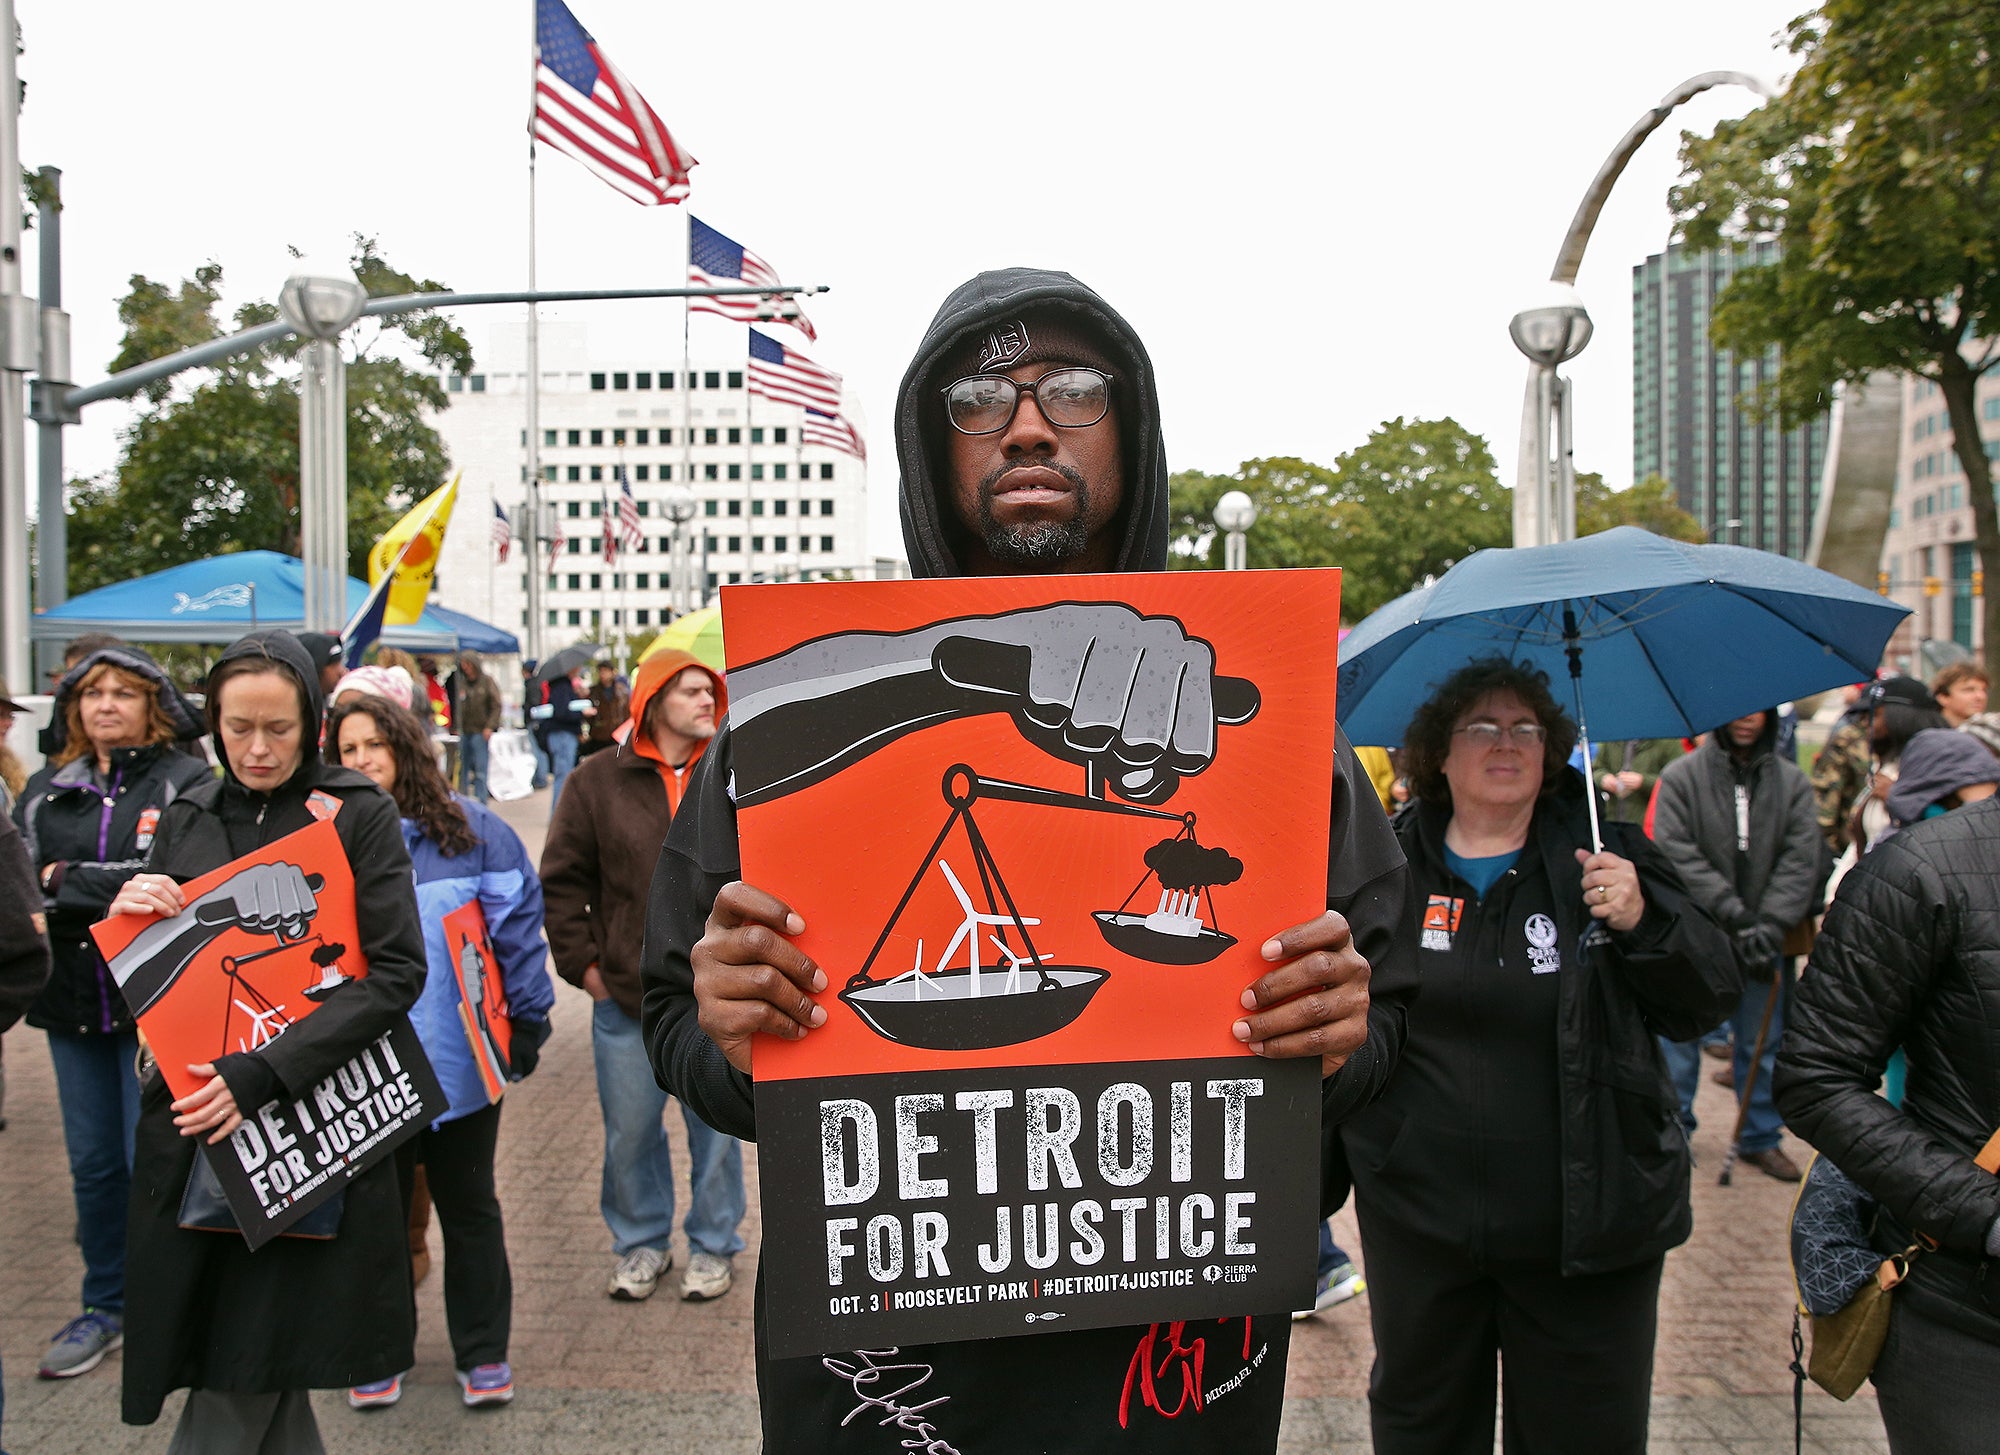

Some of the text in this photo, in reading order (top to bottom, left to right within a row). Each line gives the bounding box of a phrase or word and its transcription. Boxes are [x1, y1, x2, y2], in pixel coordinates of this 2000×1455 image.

[249, 1071, 420, 1207] FOR JUSTICE
[819, 1078, 1266, 1206] DETROIT
[825, 1192, 1258, 1287] FOR JUSTICE
[829, 1269, 1194, 1316] OCT. 3 ROOSEVELT PARK #DETROIT4JUSTICE
[1224, 1264, 1258, 1275] SIERRA
[1224, 1273, 1247, 1283] CLUB
[1204, 1366, 1252, 1405] MICHAEL
